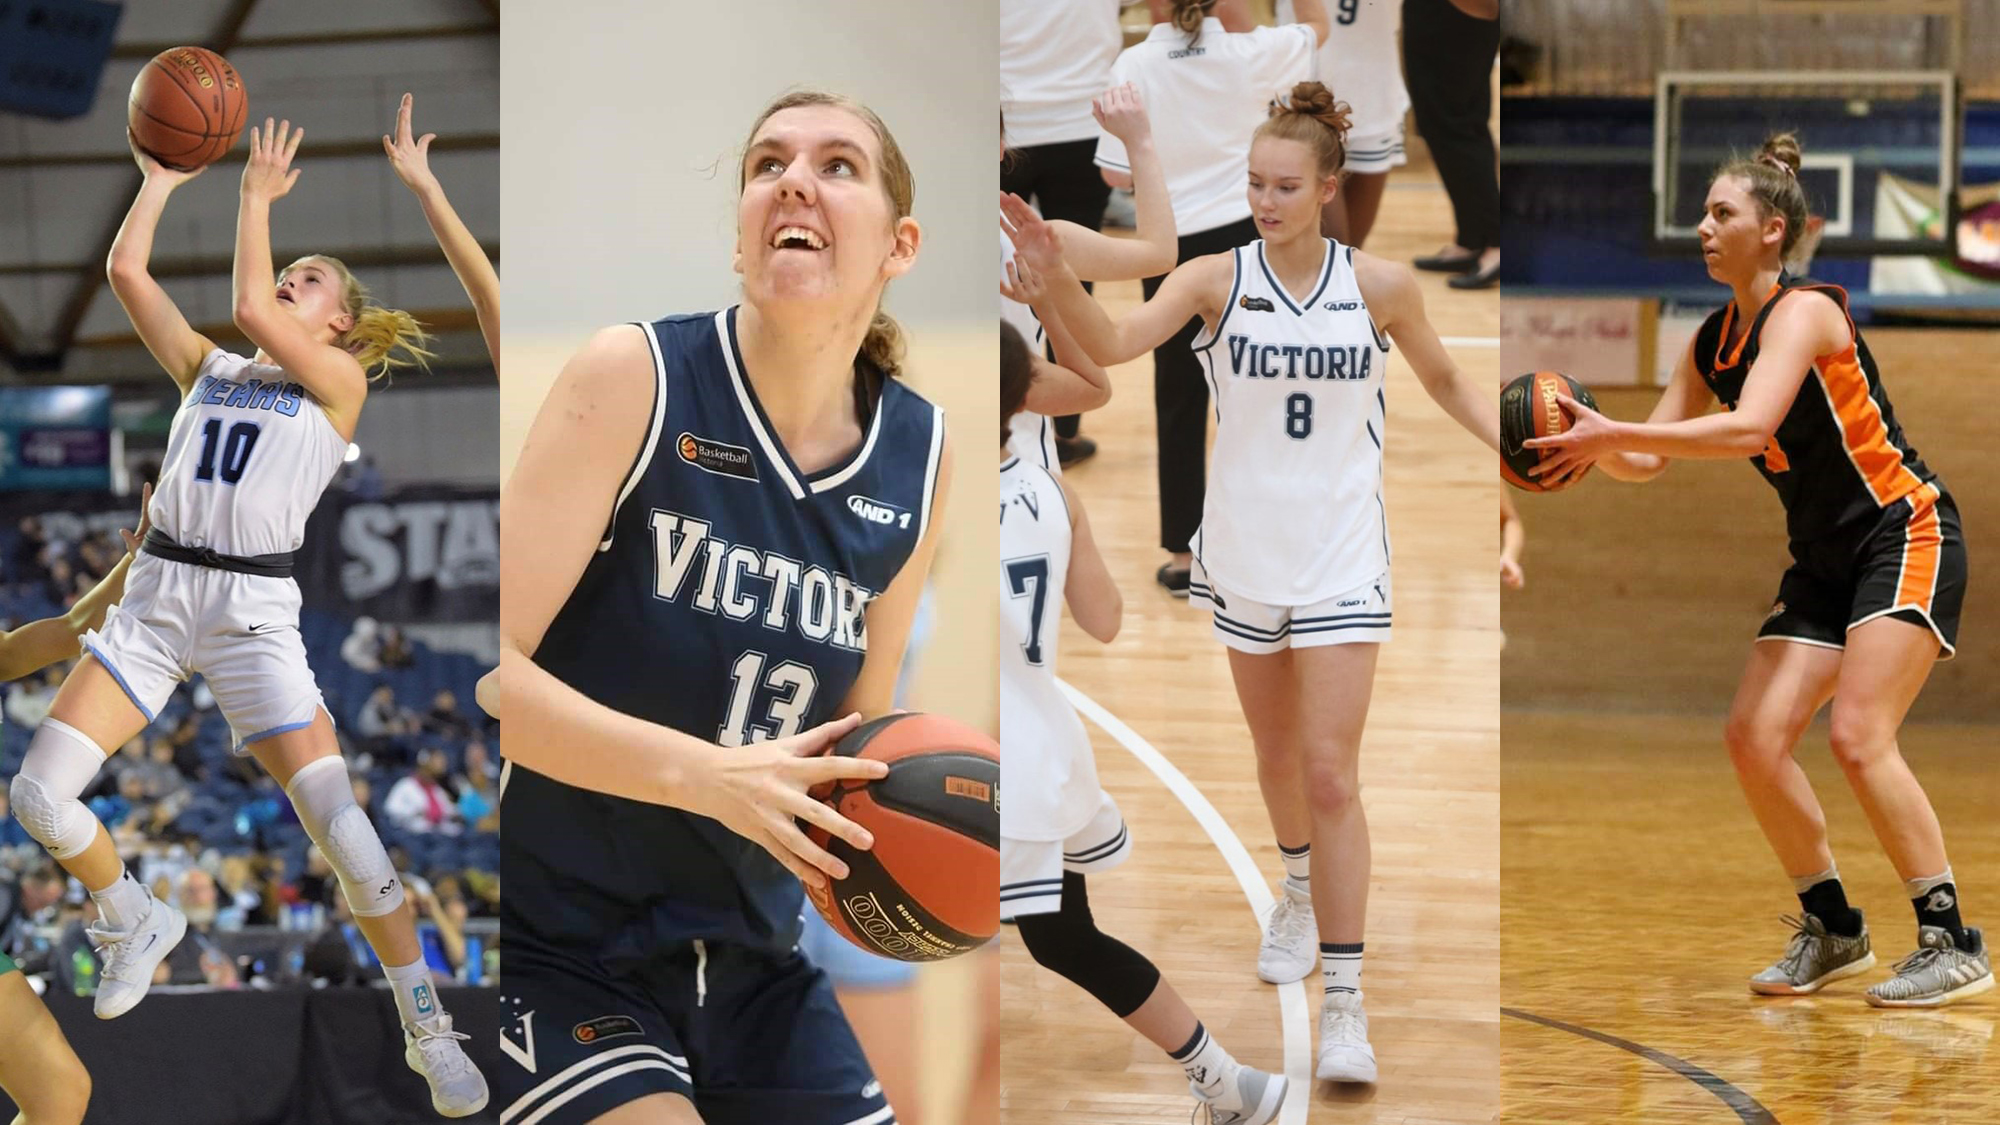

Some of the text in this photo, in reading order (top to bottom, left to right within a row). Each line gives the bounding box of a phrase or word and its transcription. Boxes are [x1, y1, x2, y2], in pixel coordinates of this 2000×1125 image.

[1337, 0, 1359, 25] 9
[1327, 301, 1359, 311] AND
[1227, 333, 1372, 380] VICTORIA
[186, 375, 305, 418] BEARS
[1284, 391, 1315, 441] 8
[1538, 378, 1560, 440] SPALDI
[194, 416, 262, 486] 10
[698, 445, 748, 465] Basketball
[851, 498, 912, 529] AND 1
[340, 502, 500, 601] STA
[1002, 553, 1052, 668] 7
[715, 650, 820, 747] 13
[896, 903, 924, 932] DESIGN
